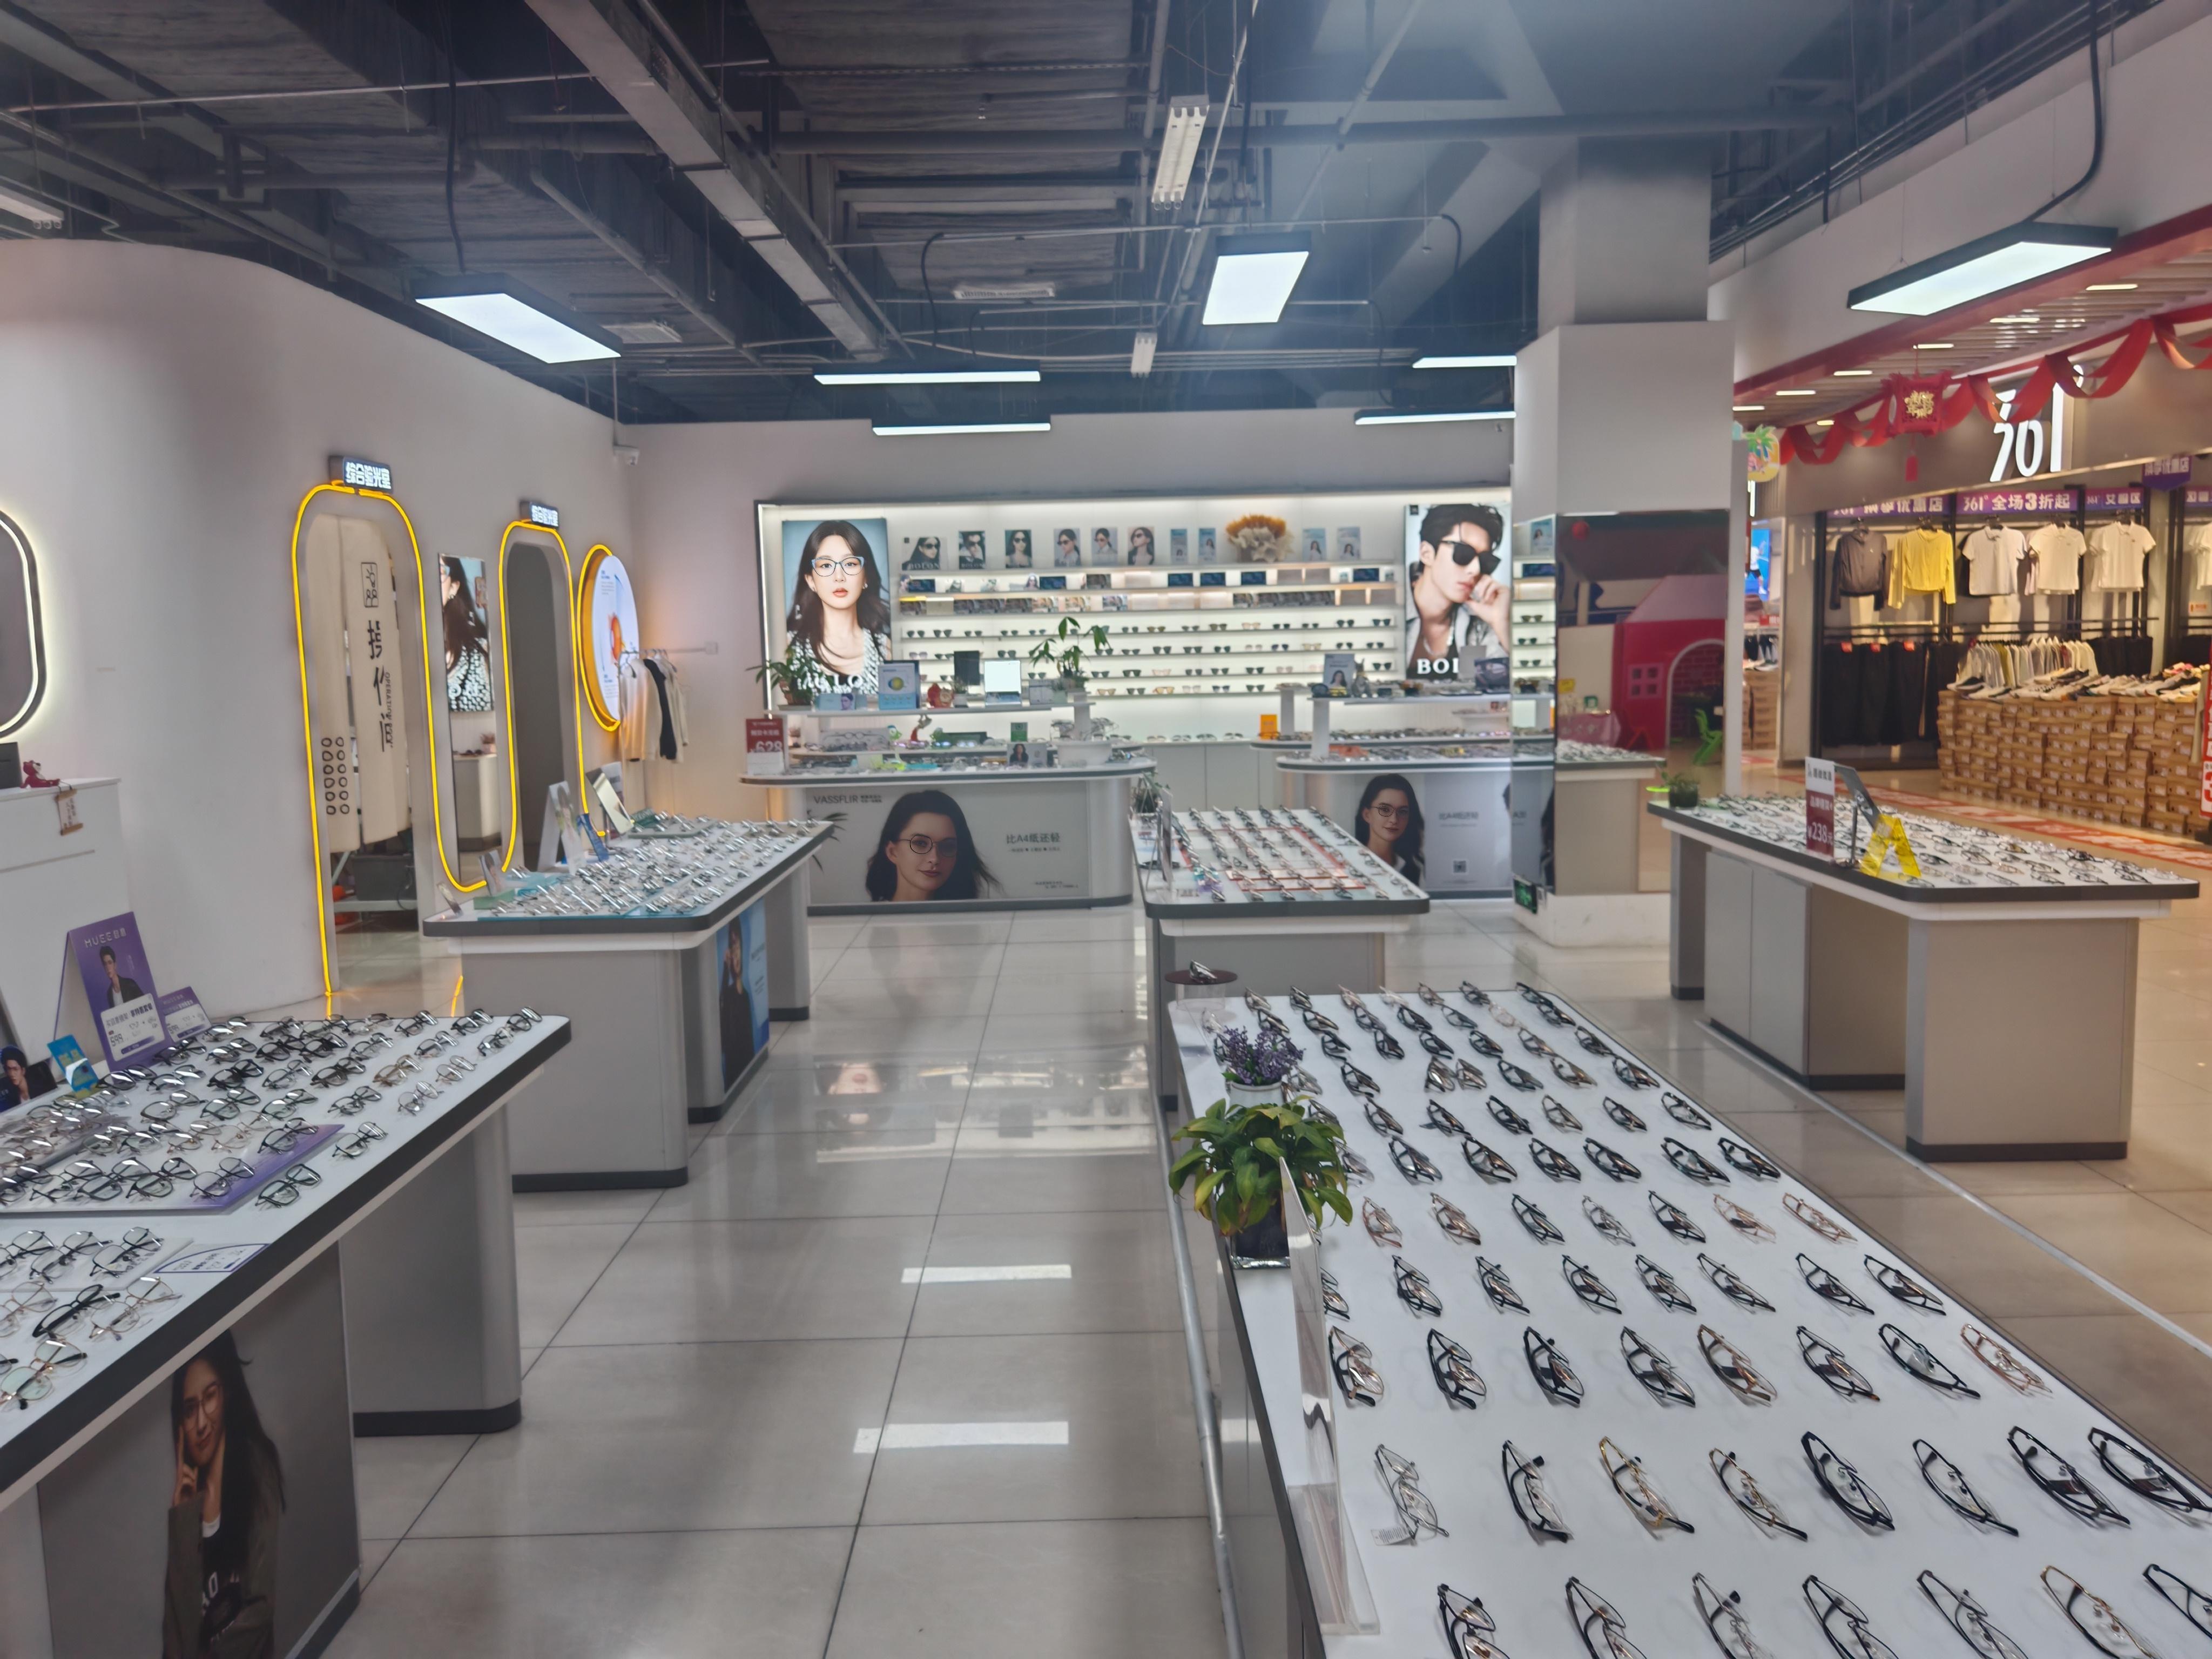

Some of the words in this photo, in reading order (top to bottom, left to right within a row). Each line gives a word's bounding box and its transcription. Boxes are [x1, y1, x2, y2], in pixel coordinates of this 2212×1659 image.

[1992, 492, 2071, 511] 全场3折起
[1006, 832, 1061, 844] 比A4纸还轻
